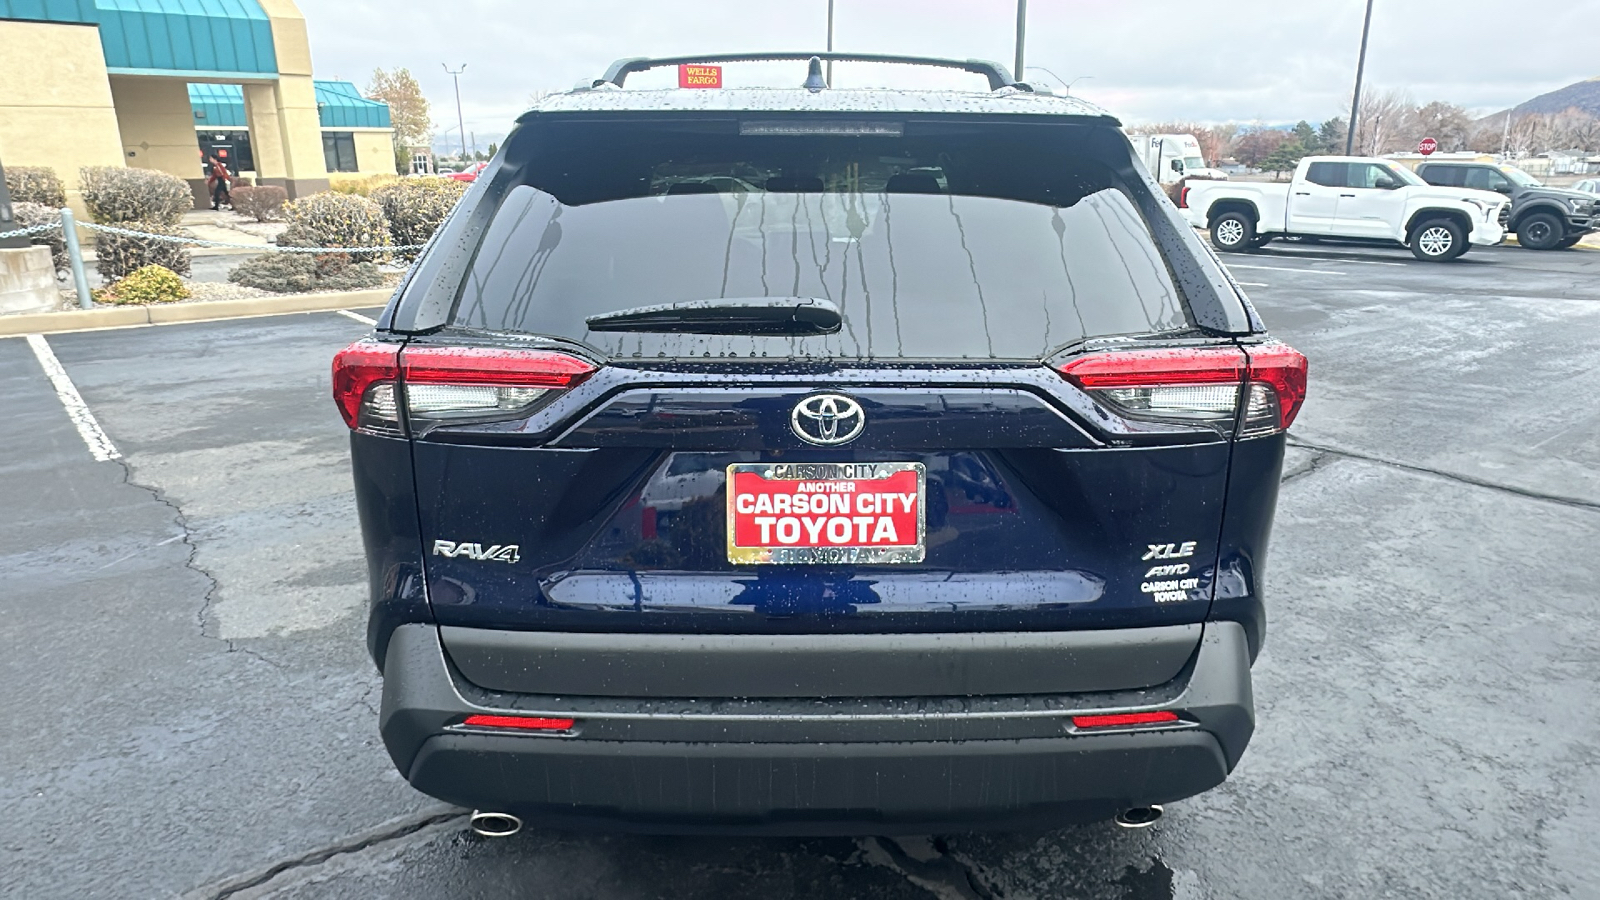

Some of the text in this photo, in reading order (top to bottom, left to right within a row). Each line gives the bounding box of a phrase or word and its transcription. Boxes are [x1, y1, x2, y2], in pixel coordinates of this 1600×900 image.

[687, 67, 717, 76] WELLS
[774, 464, 877, 479] CARSON CITY
[797, 482, 855, 492] ANOTHER
[736, 493, 917, 514] CARSON CITY
[754, 516, 898, 543] TOYOTA
[432, 540, 520, 563] RAV4
[1141, 541, 1197, 560] XLE
[1144, 563, 1190, 578] AWD
[1141, 578, 1198, 592] CARSON CITY
[1154, 590, 1187, 602] TOYOTA
